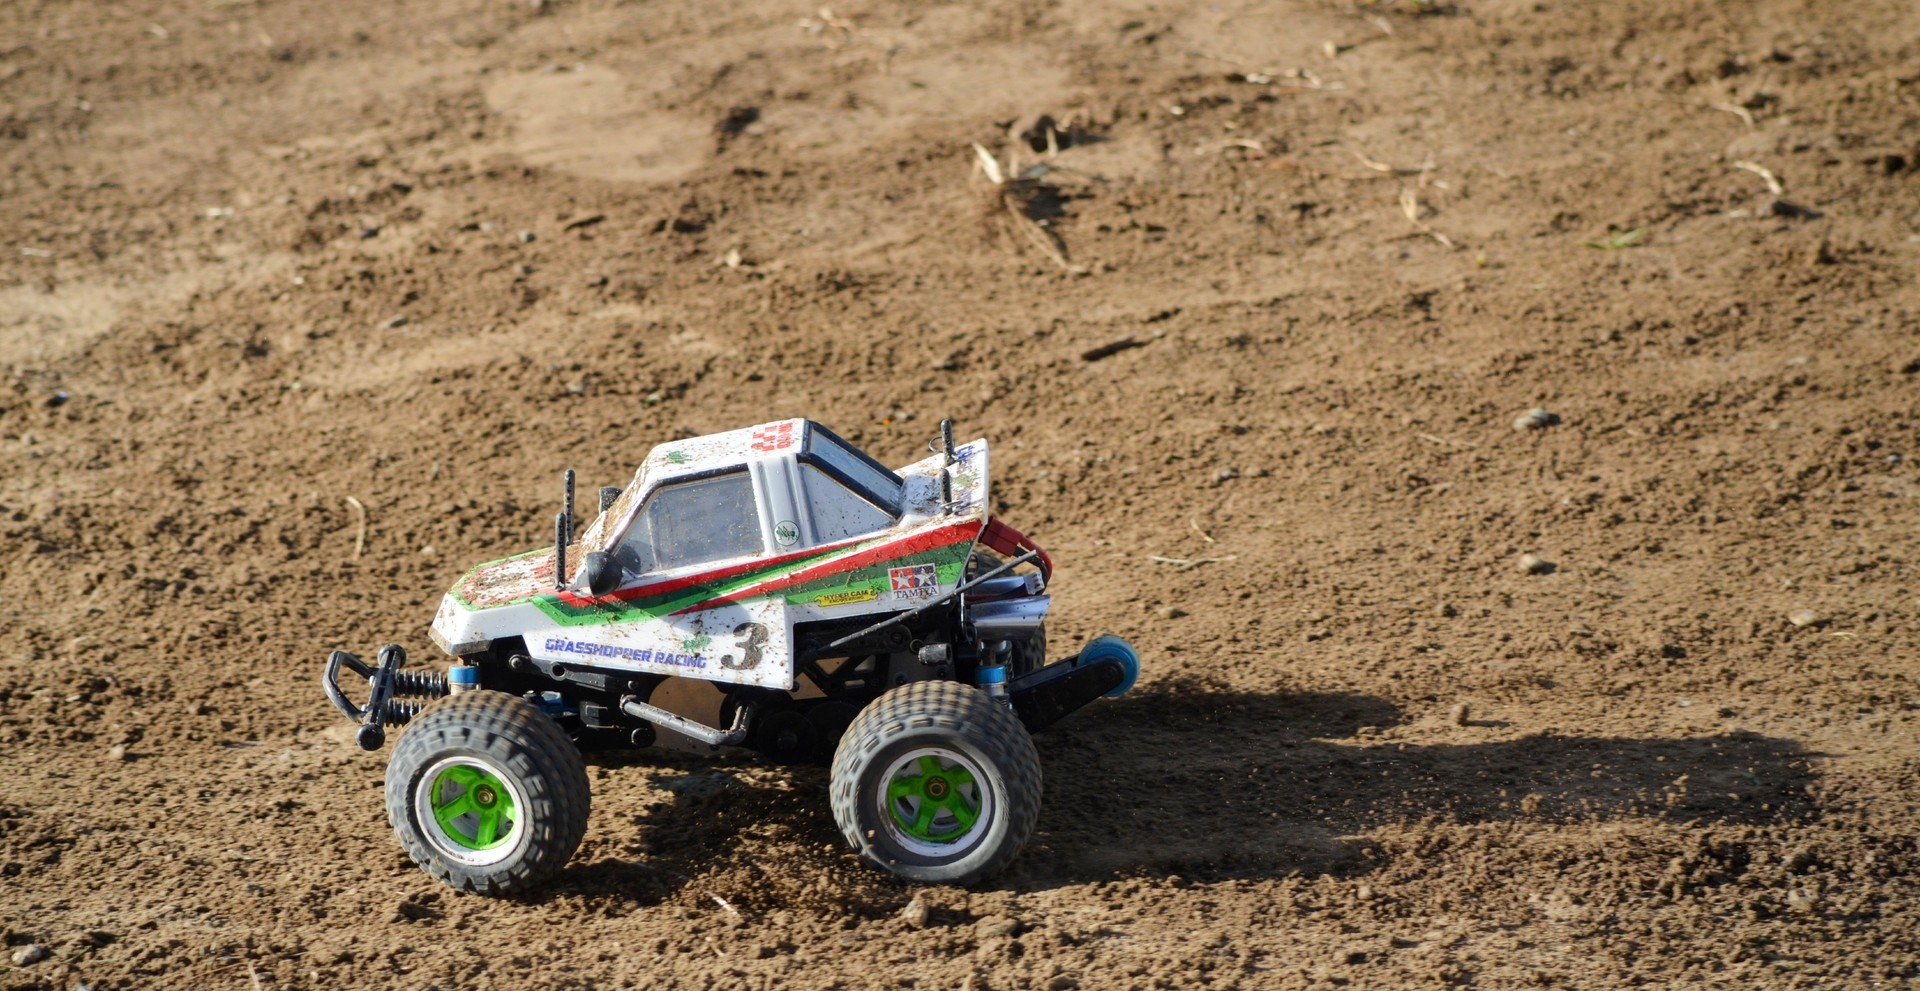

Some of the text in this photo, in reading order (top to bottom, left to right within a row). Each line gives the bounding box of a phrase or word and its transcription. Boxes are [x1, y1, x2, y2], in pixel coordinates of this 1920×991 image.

[823, 592, 849, 601] HYPER
[894, 586, 938, 600] TAMIYA
[545, 638, 707, 669] GRASSHOPPER RACING
[720, 622, 769, 671] 3
